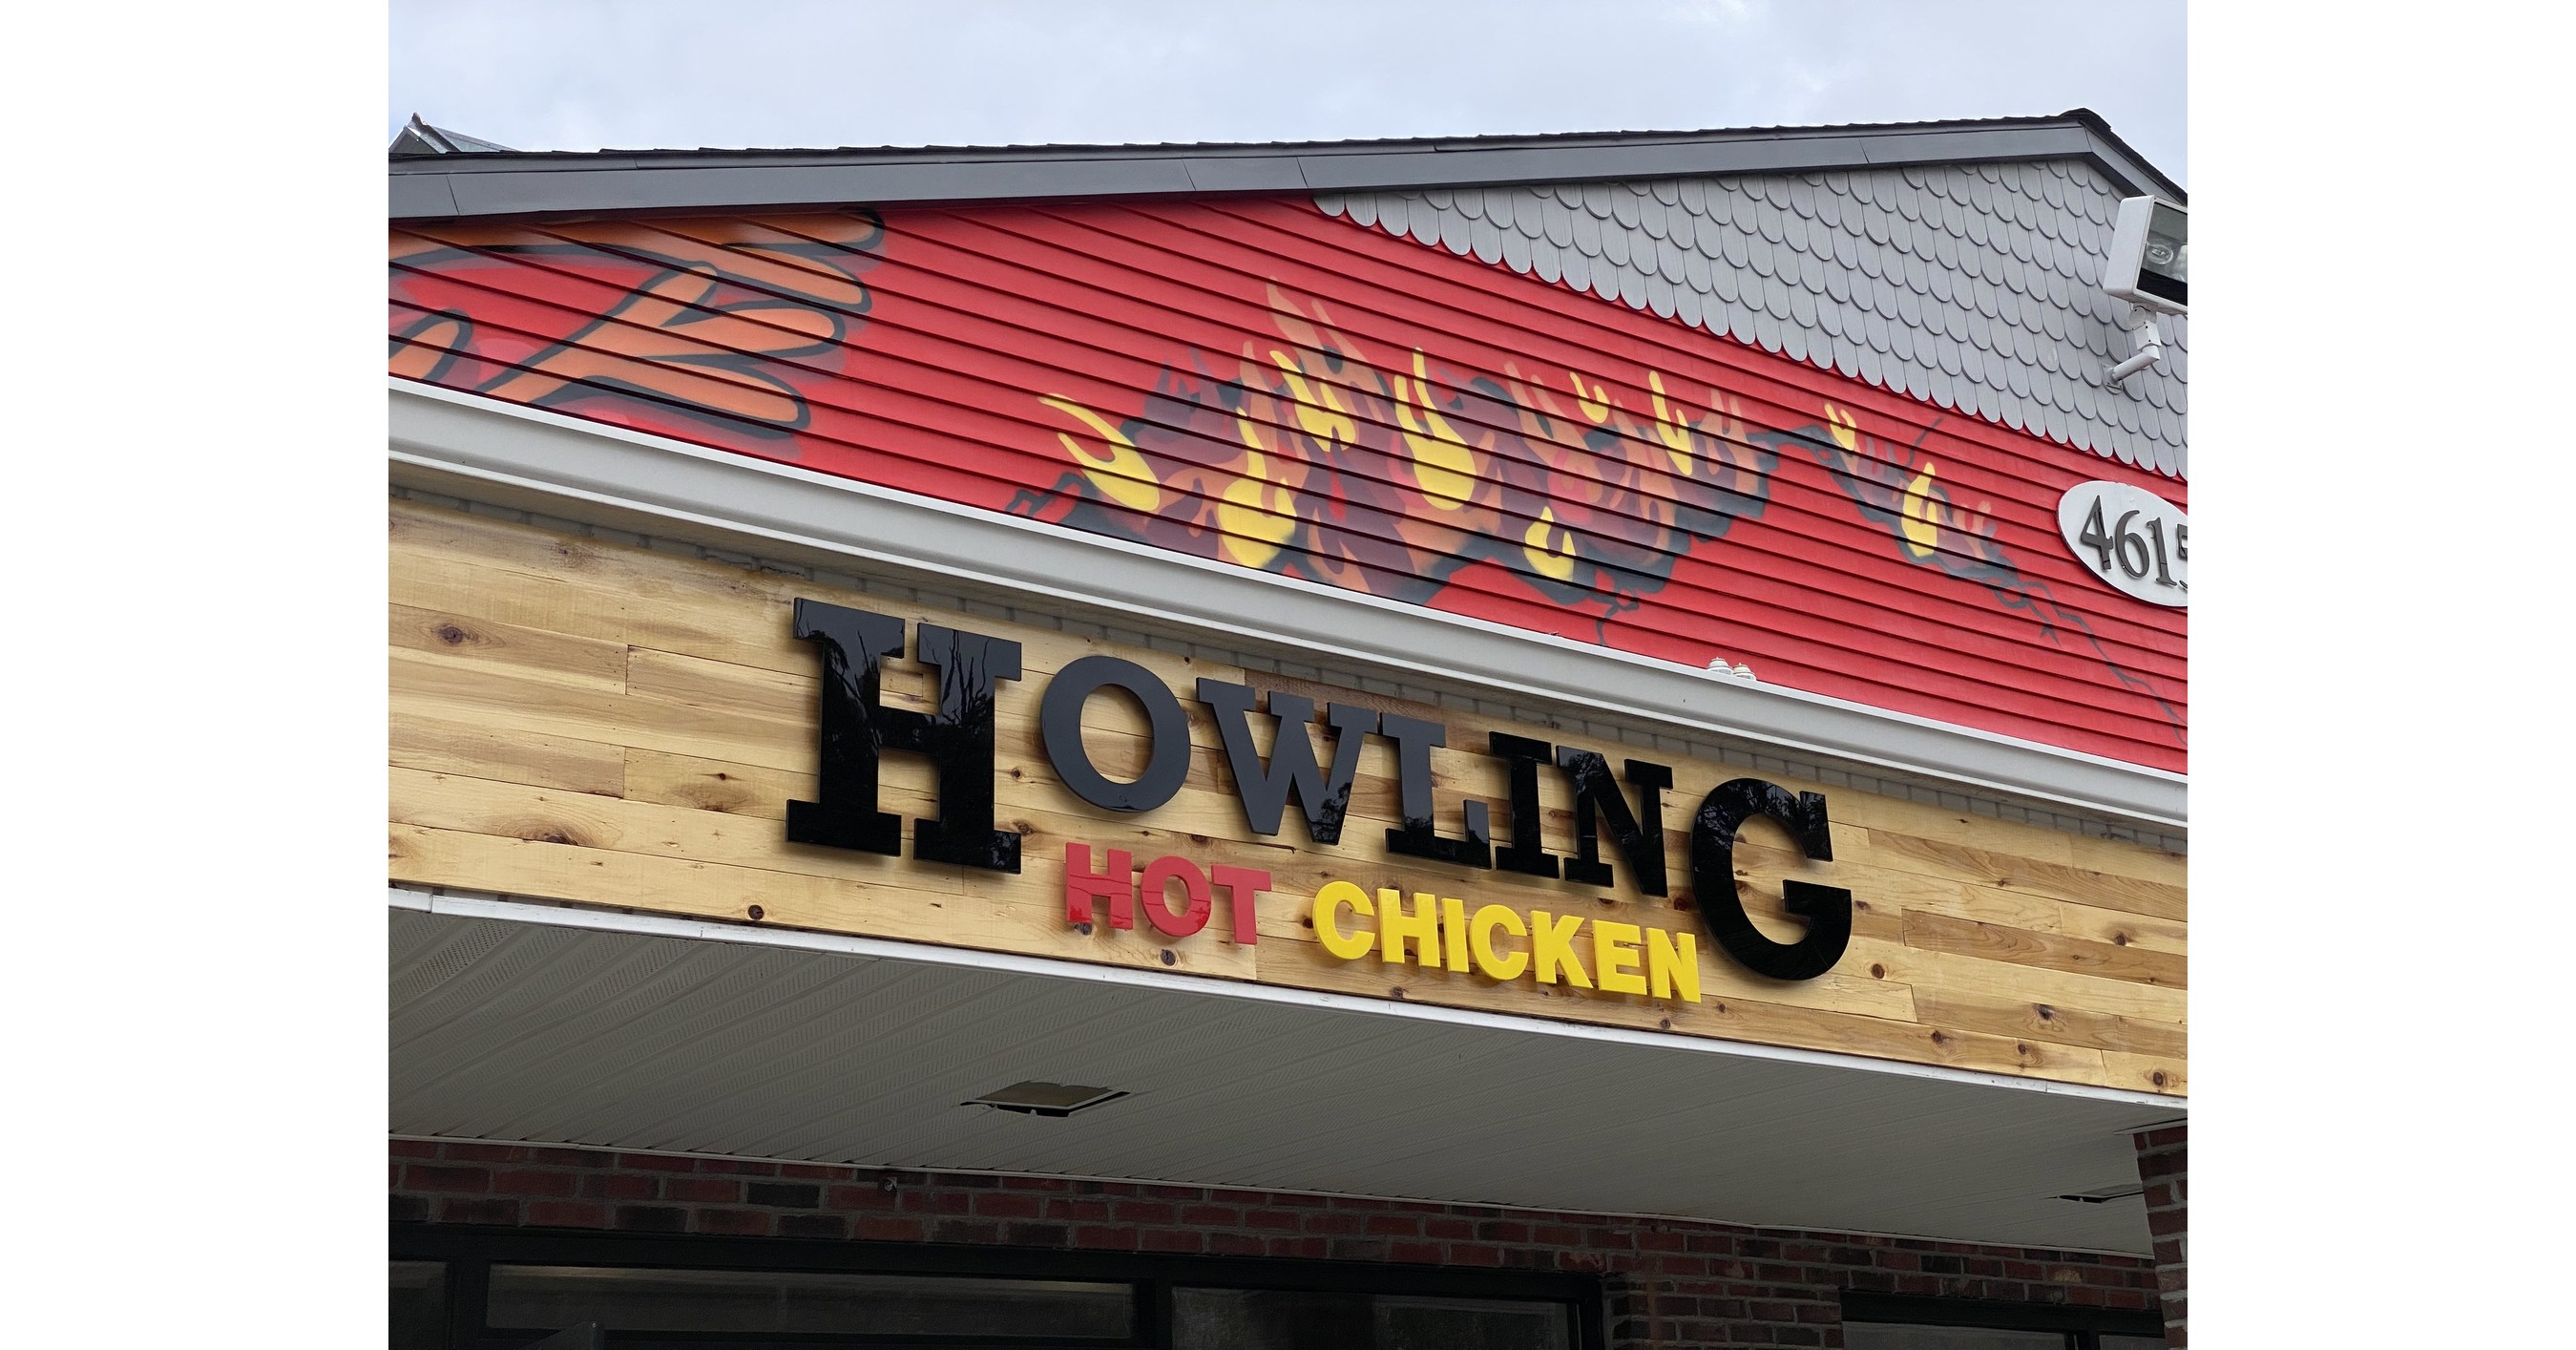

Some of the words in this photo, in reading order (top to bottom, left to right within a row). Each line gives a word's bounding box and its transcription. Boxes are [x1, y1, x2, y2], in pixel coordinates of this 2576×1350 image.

[785, 597, 1853, 981] HOWLING
[1065, 841, 1272, 945] HOT
[1312, 880, 1702, 1003] CHICKEN
